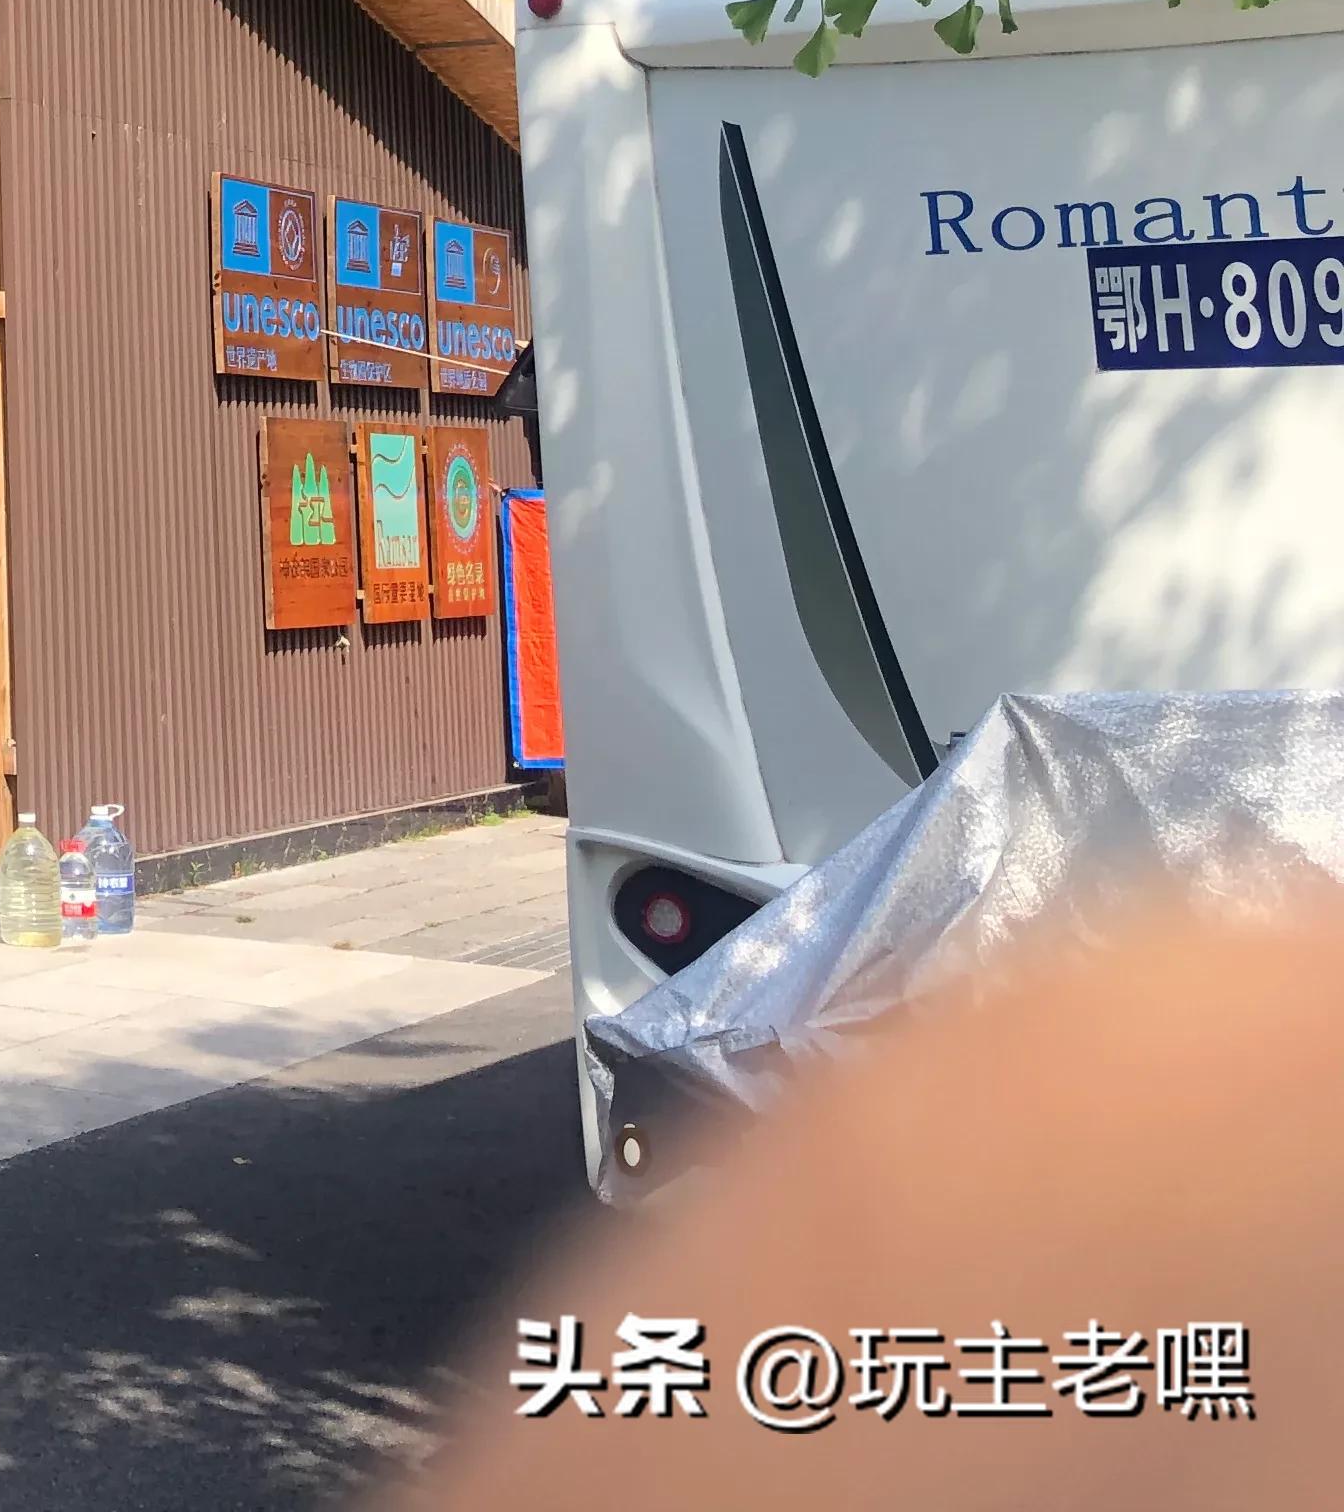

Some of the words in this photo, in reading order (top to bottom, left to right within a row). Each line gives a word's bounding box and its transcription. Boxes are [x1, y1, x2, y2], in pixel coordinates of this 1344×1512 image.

[222, 291, 321, 342] unesco
[337, 304, 426, 351] unesco
[437, 319, 515, 362] unesco
[447, 561, 485, 585] 绿色名录
